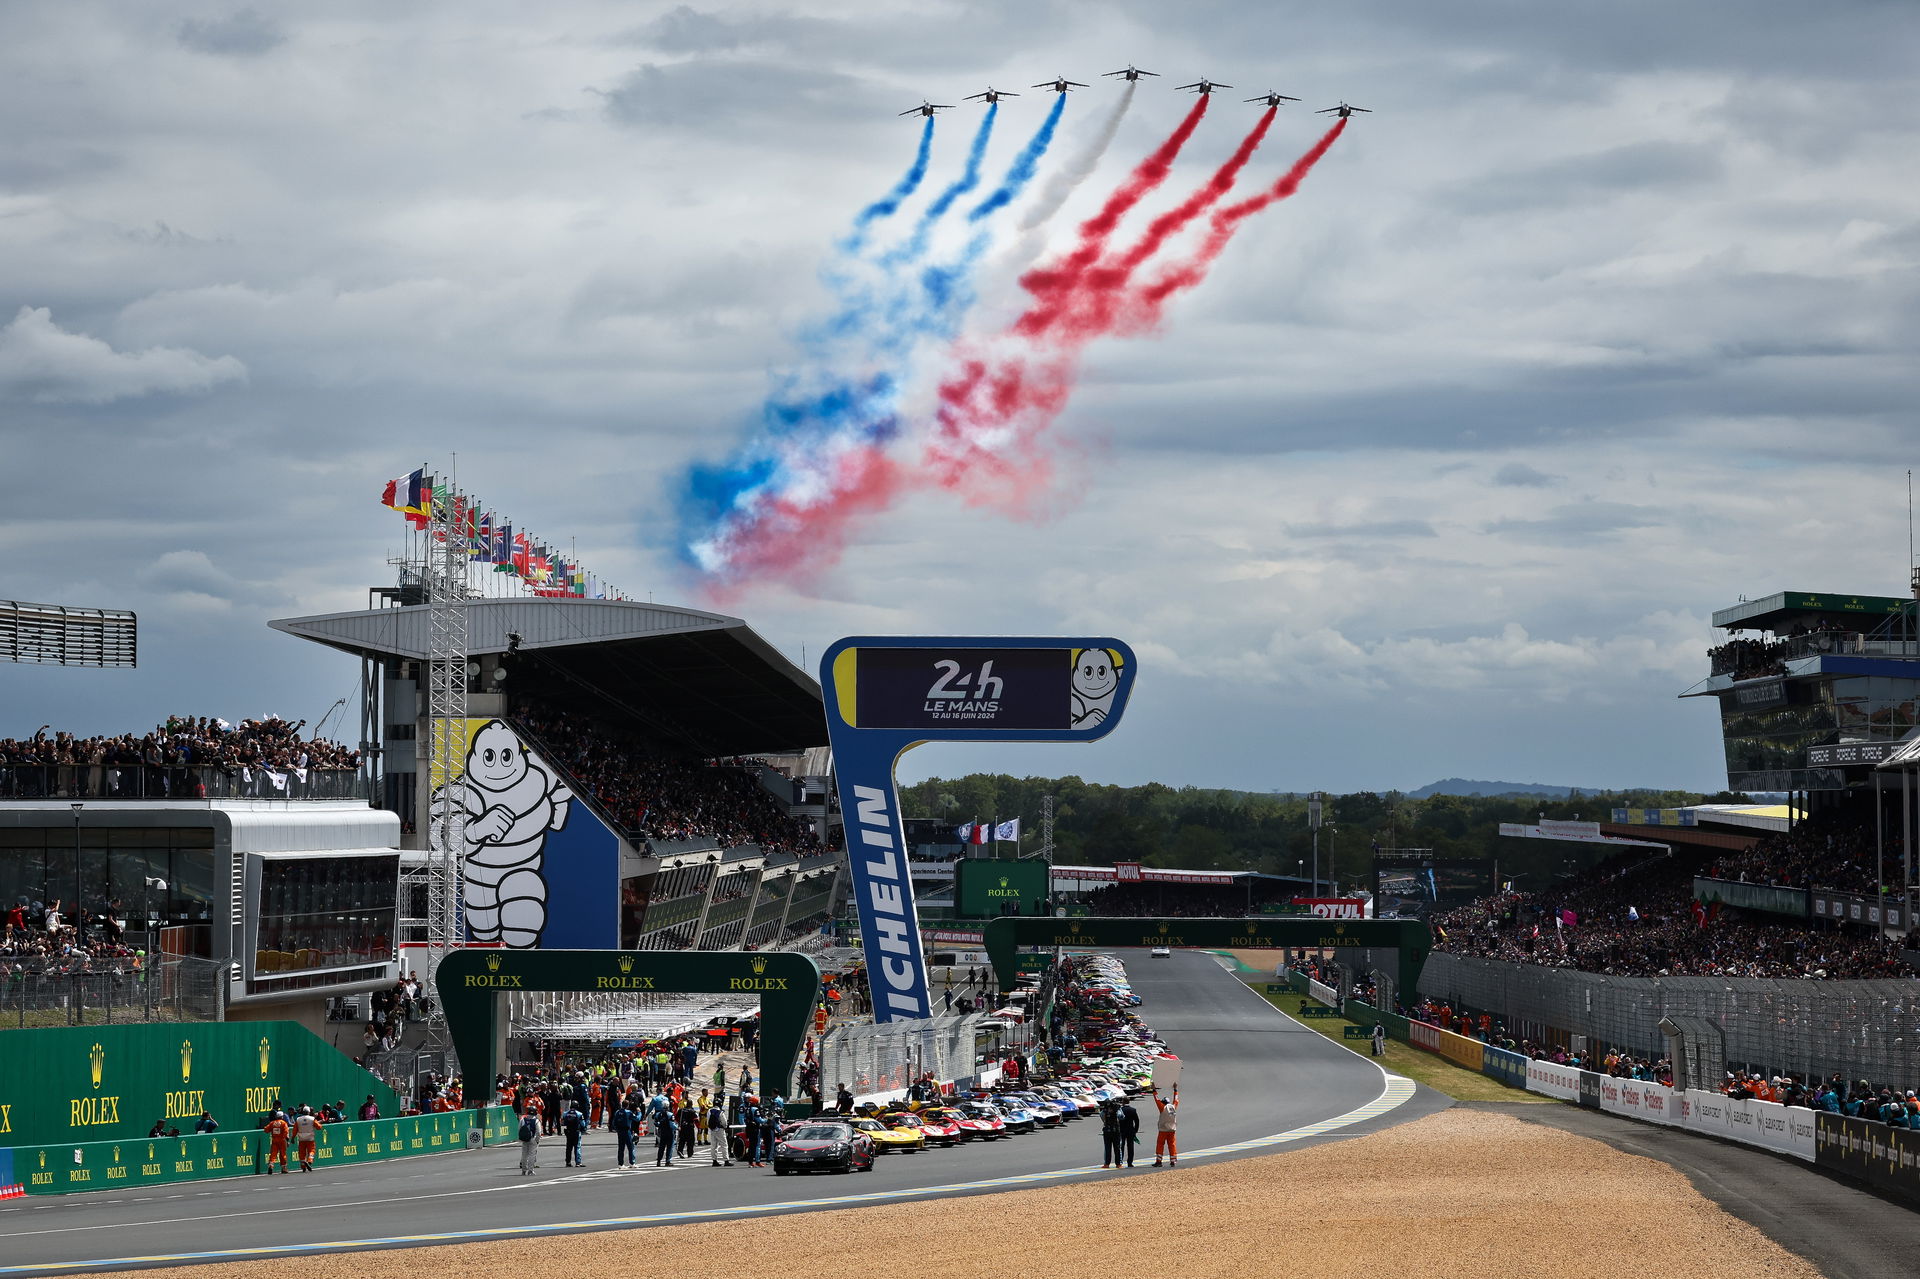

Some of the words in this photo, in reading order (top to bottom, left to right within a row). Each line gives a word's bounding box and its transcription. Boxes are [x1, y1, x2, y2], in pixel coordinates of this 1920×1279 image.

[924, 701, 945, 711] LE
[961, 712, 976, 720] JUIN
[1118, 865, 1140, 879] MOTUL
[988, 889, 1020, 897] ROLEX
[853, 785, 920, 1023] ICHELIN
[1311, 904, 1362, 919] OTUL
[1054, 936, 1096, 945] ROLEX
[1143, 937, 1184, 945] ROLEX
[1231, 937, 1272, 946] ROLEX
[1319, 937, 1361, 946] ROLEX
[464, 975, 522, 988] ROLEX
[597, 976, 655, 989] ROLEX
[730, 977, 788, 990] ROLEX
[165, 1091, 204, 1118] ROLEX
[71, 1097, 119, 1126] ROLEX
[318, 1148, 332, 1158] ROLEX
[344, 1146, 357, 1156] ROLEX
[207, 1158, 224, 1169] ROLEX
[237, 1155, 253, 1166] ROLEX
[143, 1164, 161, 1175] ROLEX
[176, 1161, 193, 1172] ROLEX
[32, 1172, 52, 1184] ROLEX
[70, 1170, 90, 1181] ROLEX
[107, 1167, 126, 1178] ROLEX
